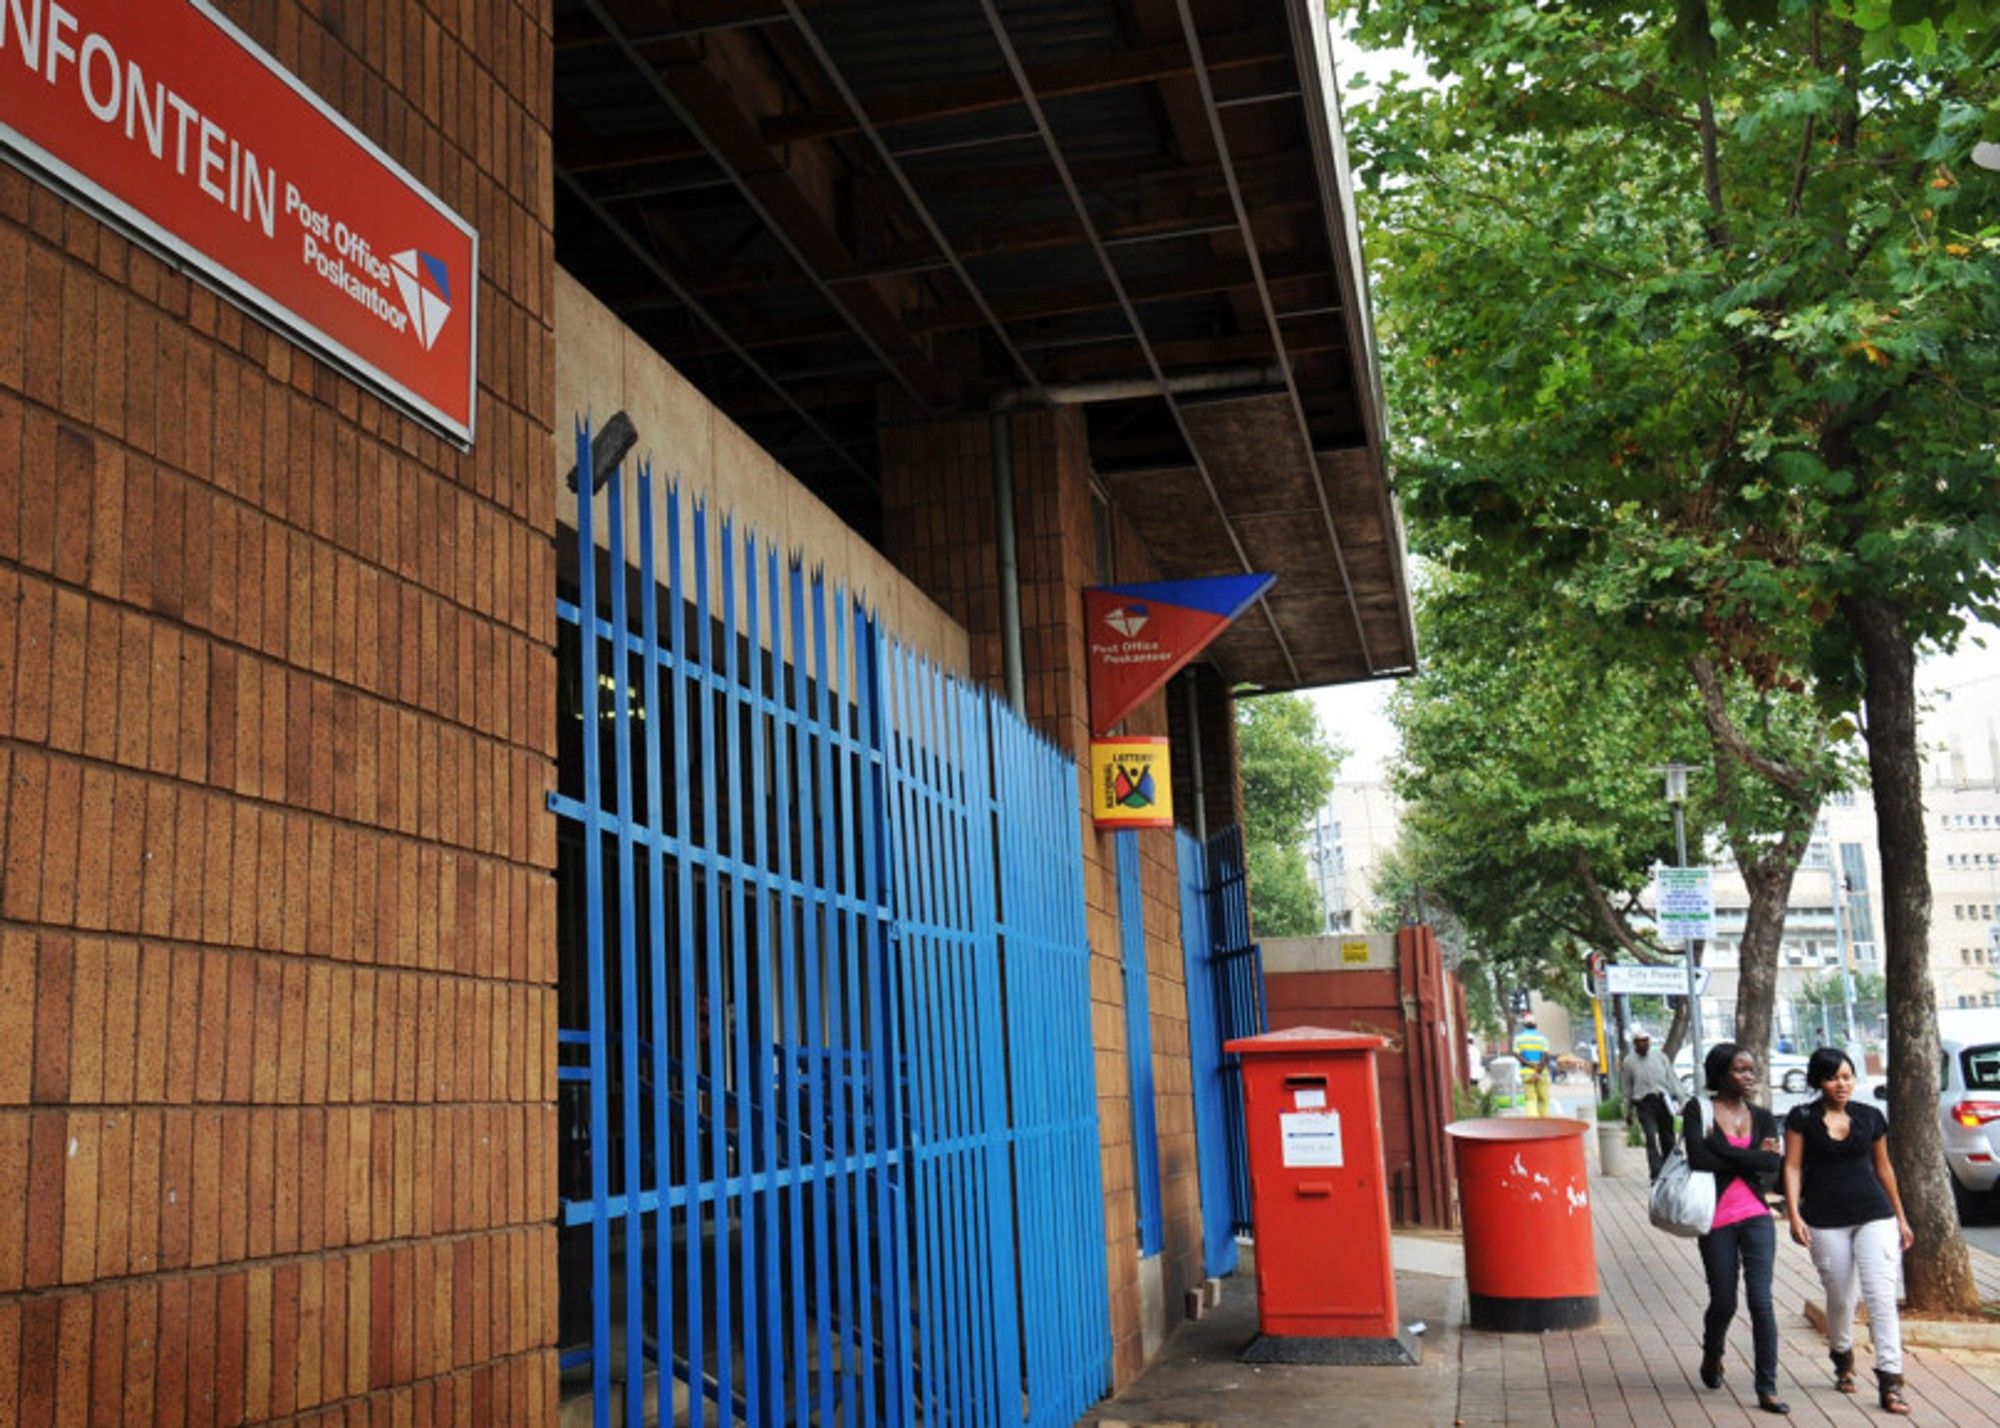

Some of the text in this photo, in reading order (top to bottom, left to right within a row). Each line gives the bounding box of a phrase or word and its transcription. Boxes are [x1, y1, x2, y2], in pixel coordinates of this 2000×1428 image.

[286, 182, 390, 288] Post Office
[304, 233, 407, 334] Poskantoor
[1093, 641, 1158, 655] Post Office
[1104, 652, 1171, 663] Poskantoor
[1628, 968, 1683, 980] City Power
